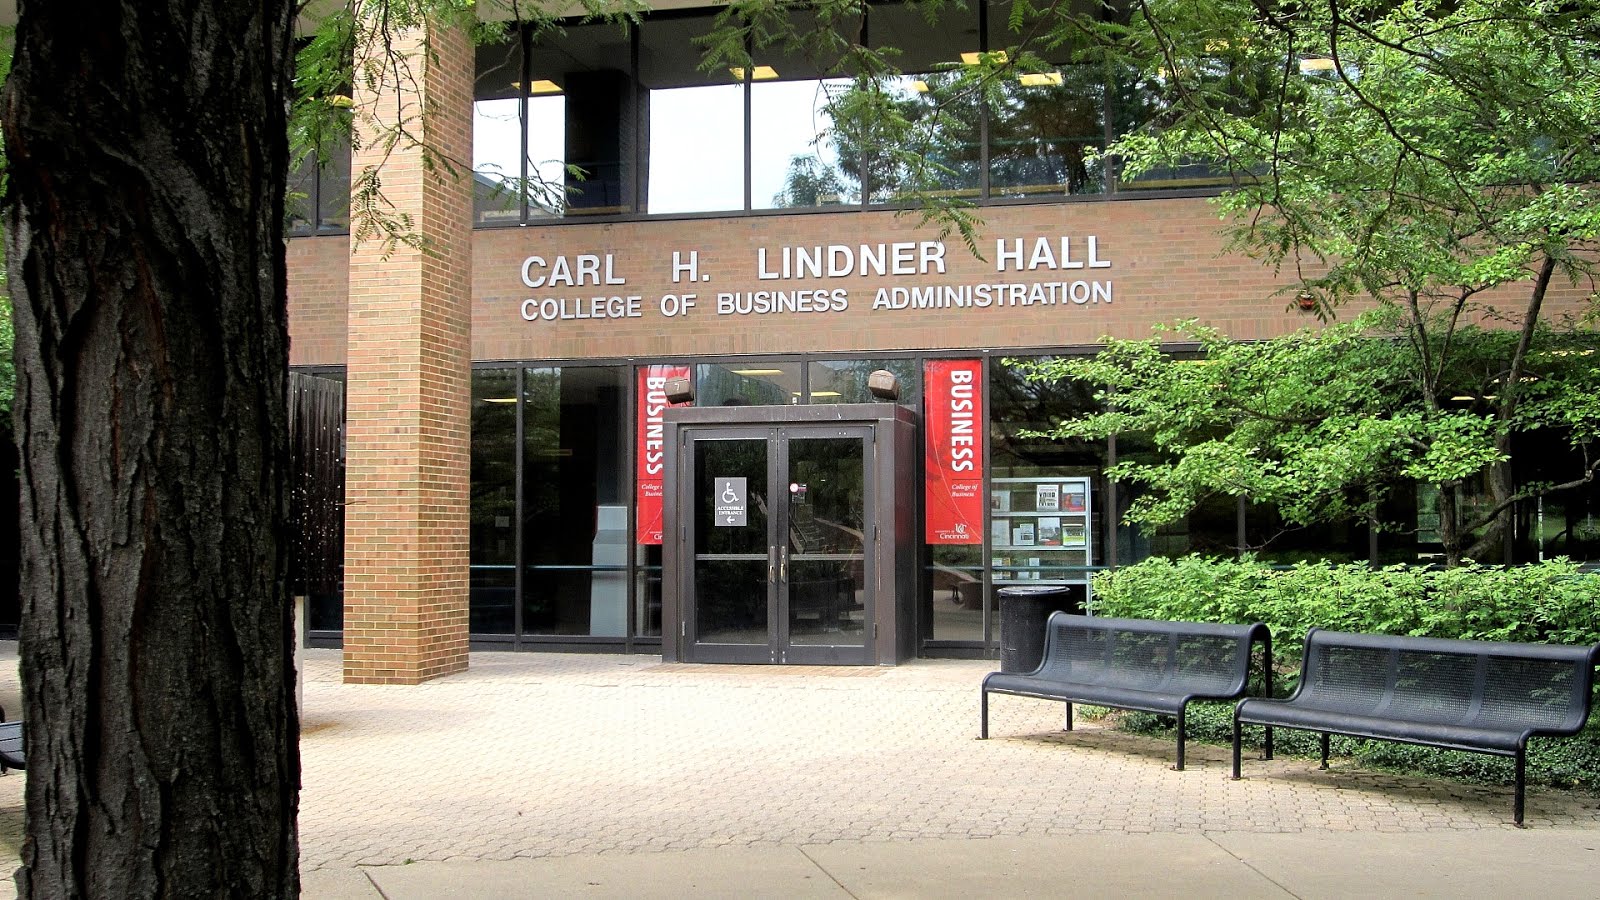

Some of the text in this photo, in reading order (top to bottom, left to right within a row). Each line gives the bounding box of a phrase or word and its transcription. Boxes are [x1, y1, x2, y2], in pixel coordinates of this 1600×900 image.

[521, 235, 1111, 288] CARL H. LINDNER HALL
[520, 280, 1113, 321] COLLEGE OF BUSINESS ADMINISTRATION
[646, 376, 667, 475] BUSINESS
[950, 370, 974, 472] BUSINESS
